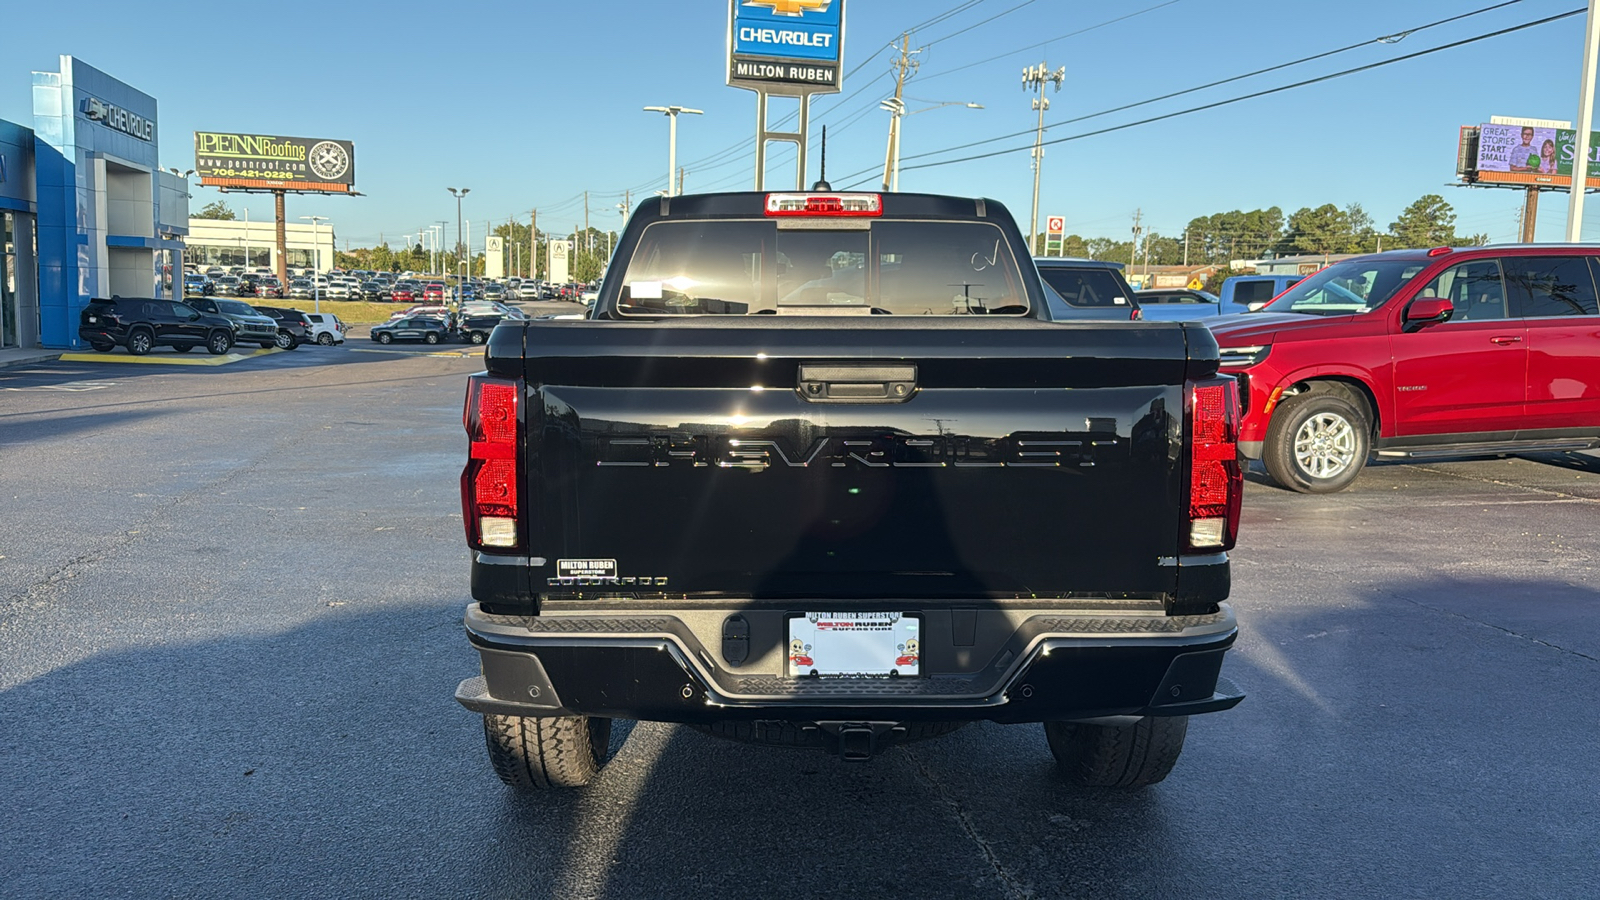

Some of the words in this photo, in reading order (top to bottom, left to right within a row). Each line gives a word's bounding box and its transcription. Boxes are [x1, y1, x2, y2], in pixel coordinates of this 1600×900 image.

[740, 27, 832, 47] CHEVROLET
[737, 63, 784, 78] MILTON
[789, 68, 833, 81] RUBEN
[108, 104, 154, 142] CHEVROLET
[1483, 127, 1509, 136] GREAT
[1482, 136, 1515, 145] STORIES
[263, 141, 306, 161] Roofing
[1481, 145, 1506, 153] START
[1480, 153, 1508, 162] SMALL
[199, 158, 306, 171] www.pennroof.com
[212, 168, 294, 179] 706-421-0226
[597, 436, 1118, 468] CHEVROLET
[560, 561, 588, 569] MILTON
[589, 561, 614, 569] RUBEN
